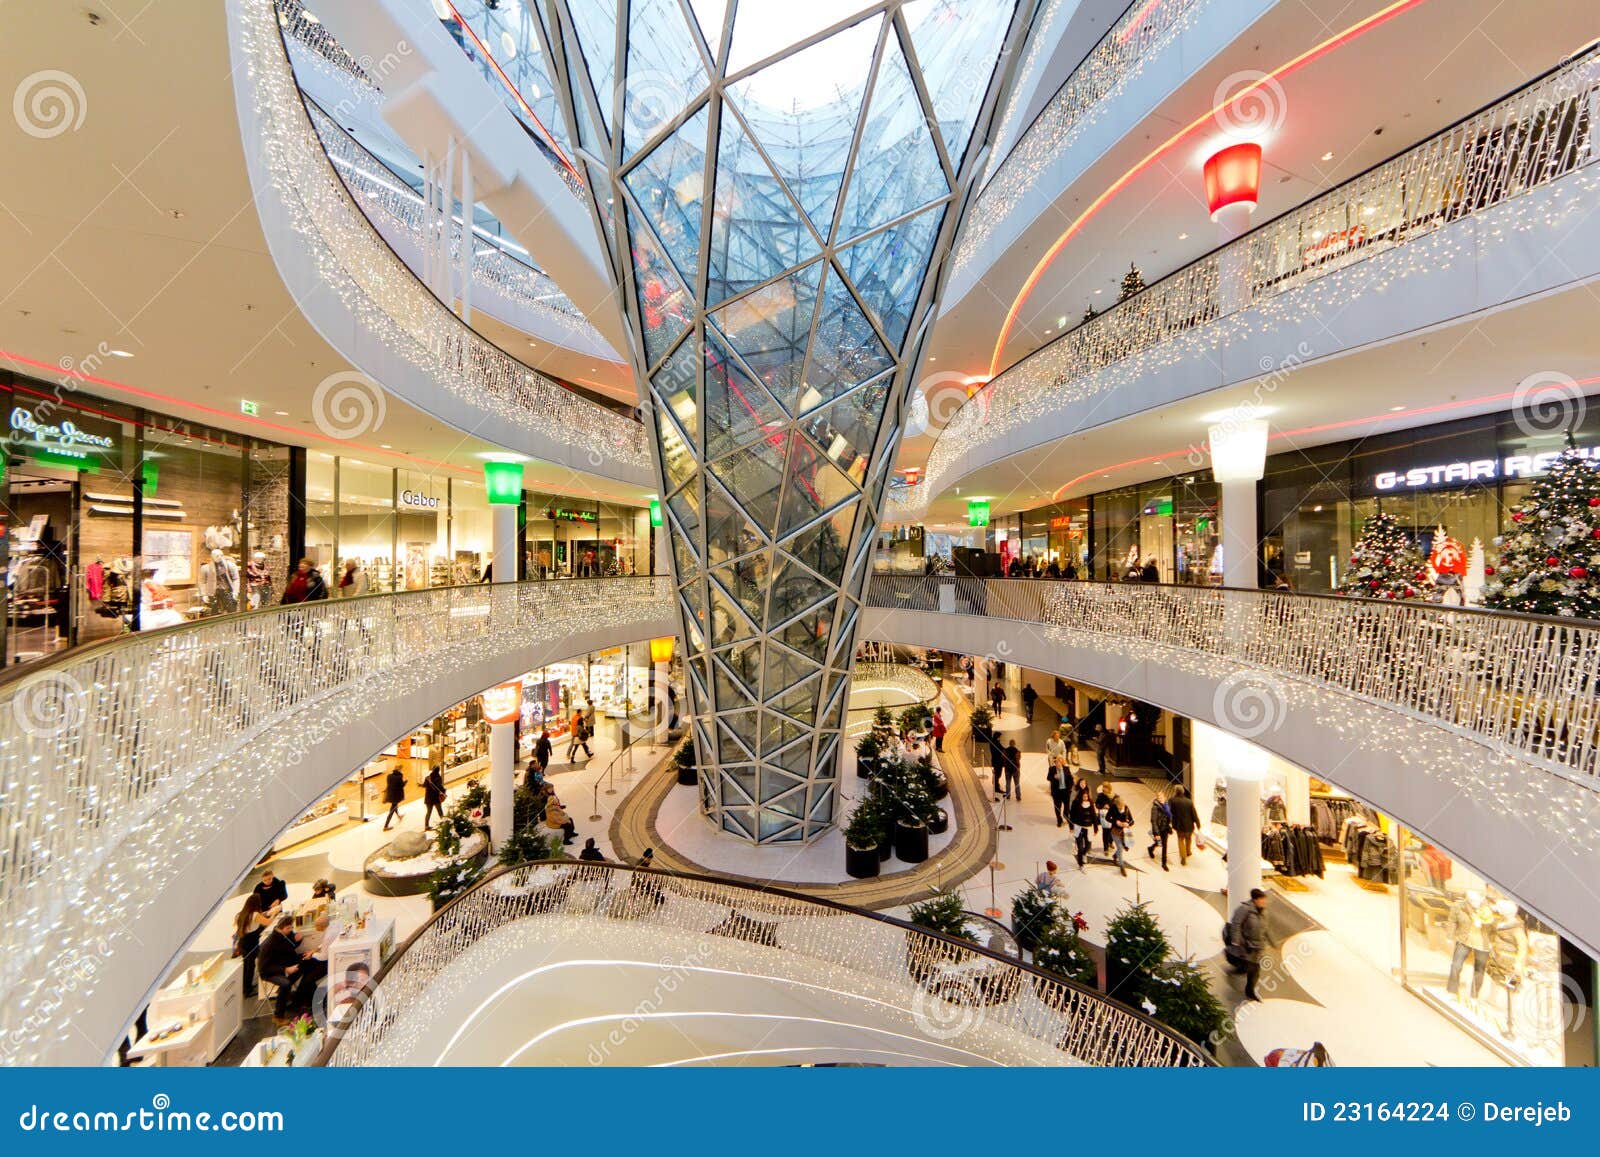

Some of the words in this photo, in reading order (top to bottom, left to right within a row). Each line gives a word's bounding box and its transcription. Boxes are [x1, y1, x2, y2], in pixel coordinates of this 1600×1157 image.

[10, 408, 60, 441] Pepe
[59, 421, 114, 447] Jeans
[1375, 459, 1495, 490] G-STAR
[402, 489, 440, 508] Gabor
